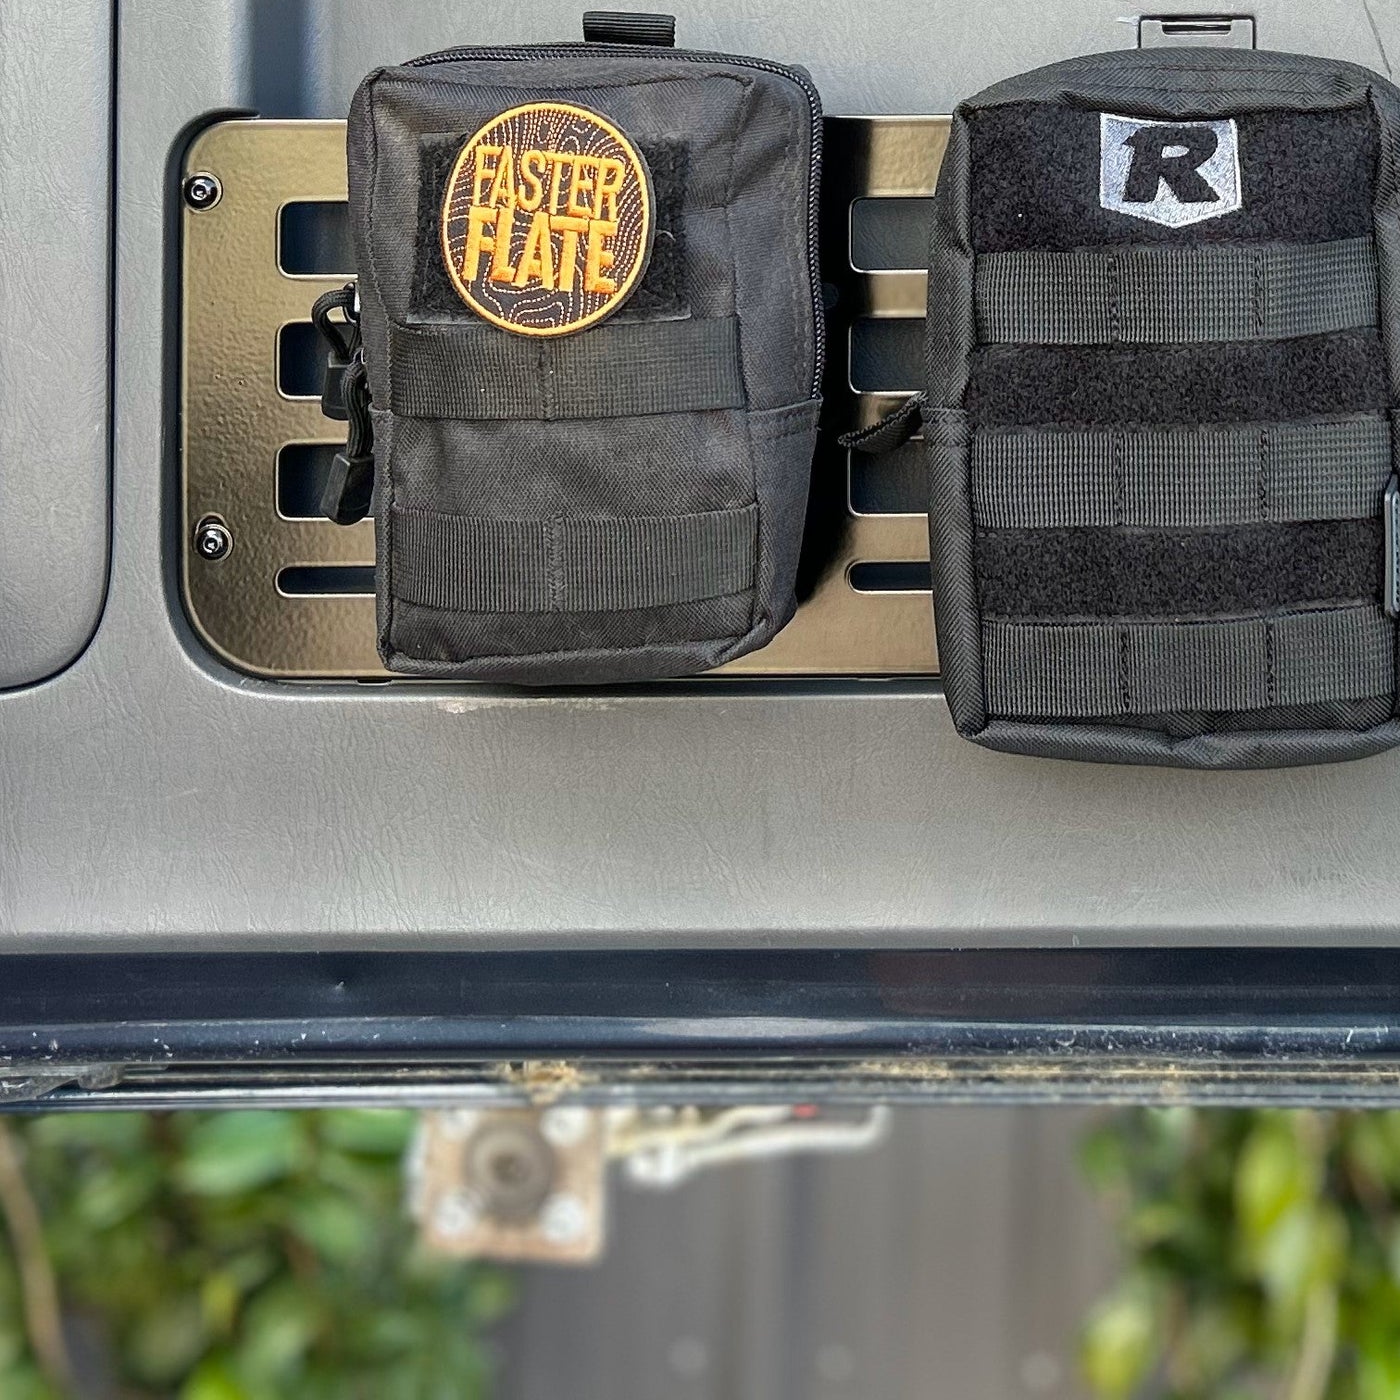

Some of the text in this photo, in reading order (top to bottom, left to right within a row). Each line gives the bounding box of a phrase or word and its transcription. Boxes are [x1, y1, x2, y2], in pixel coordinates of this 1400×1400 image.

[472, 145, 625, 221] FASTER
[1122, 126, 1220, 203] R
[462, 205, 619, 294] FLATE
